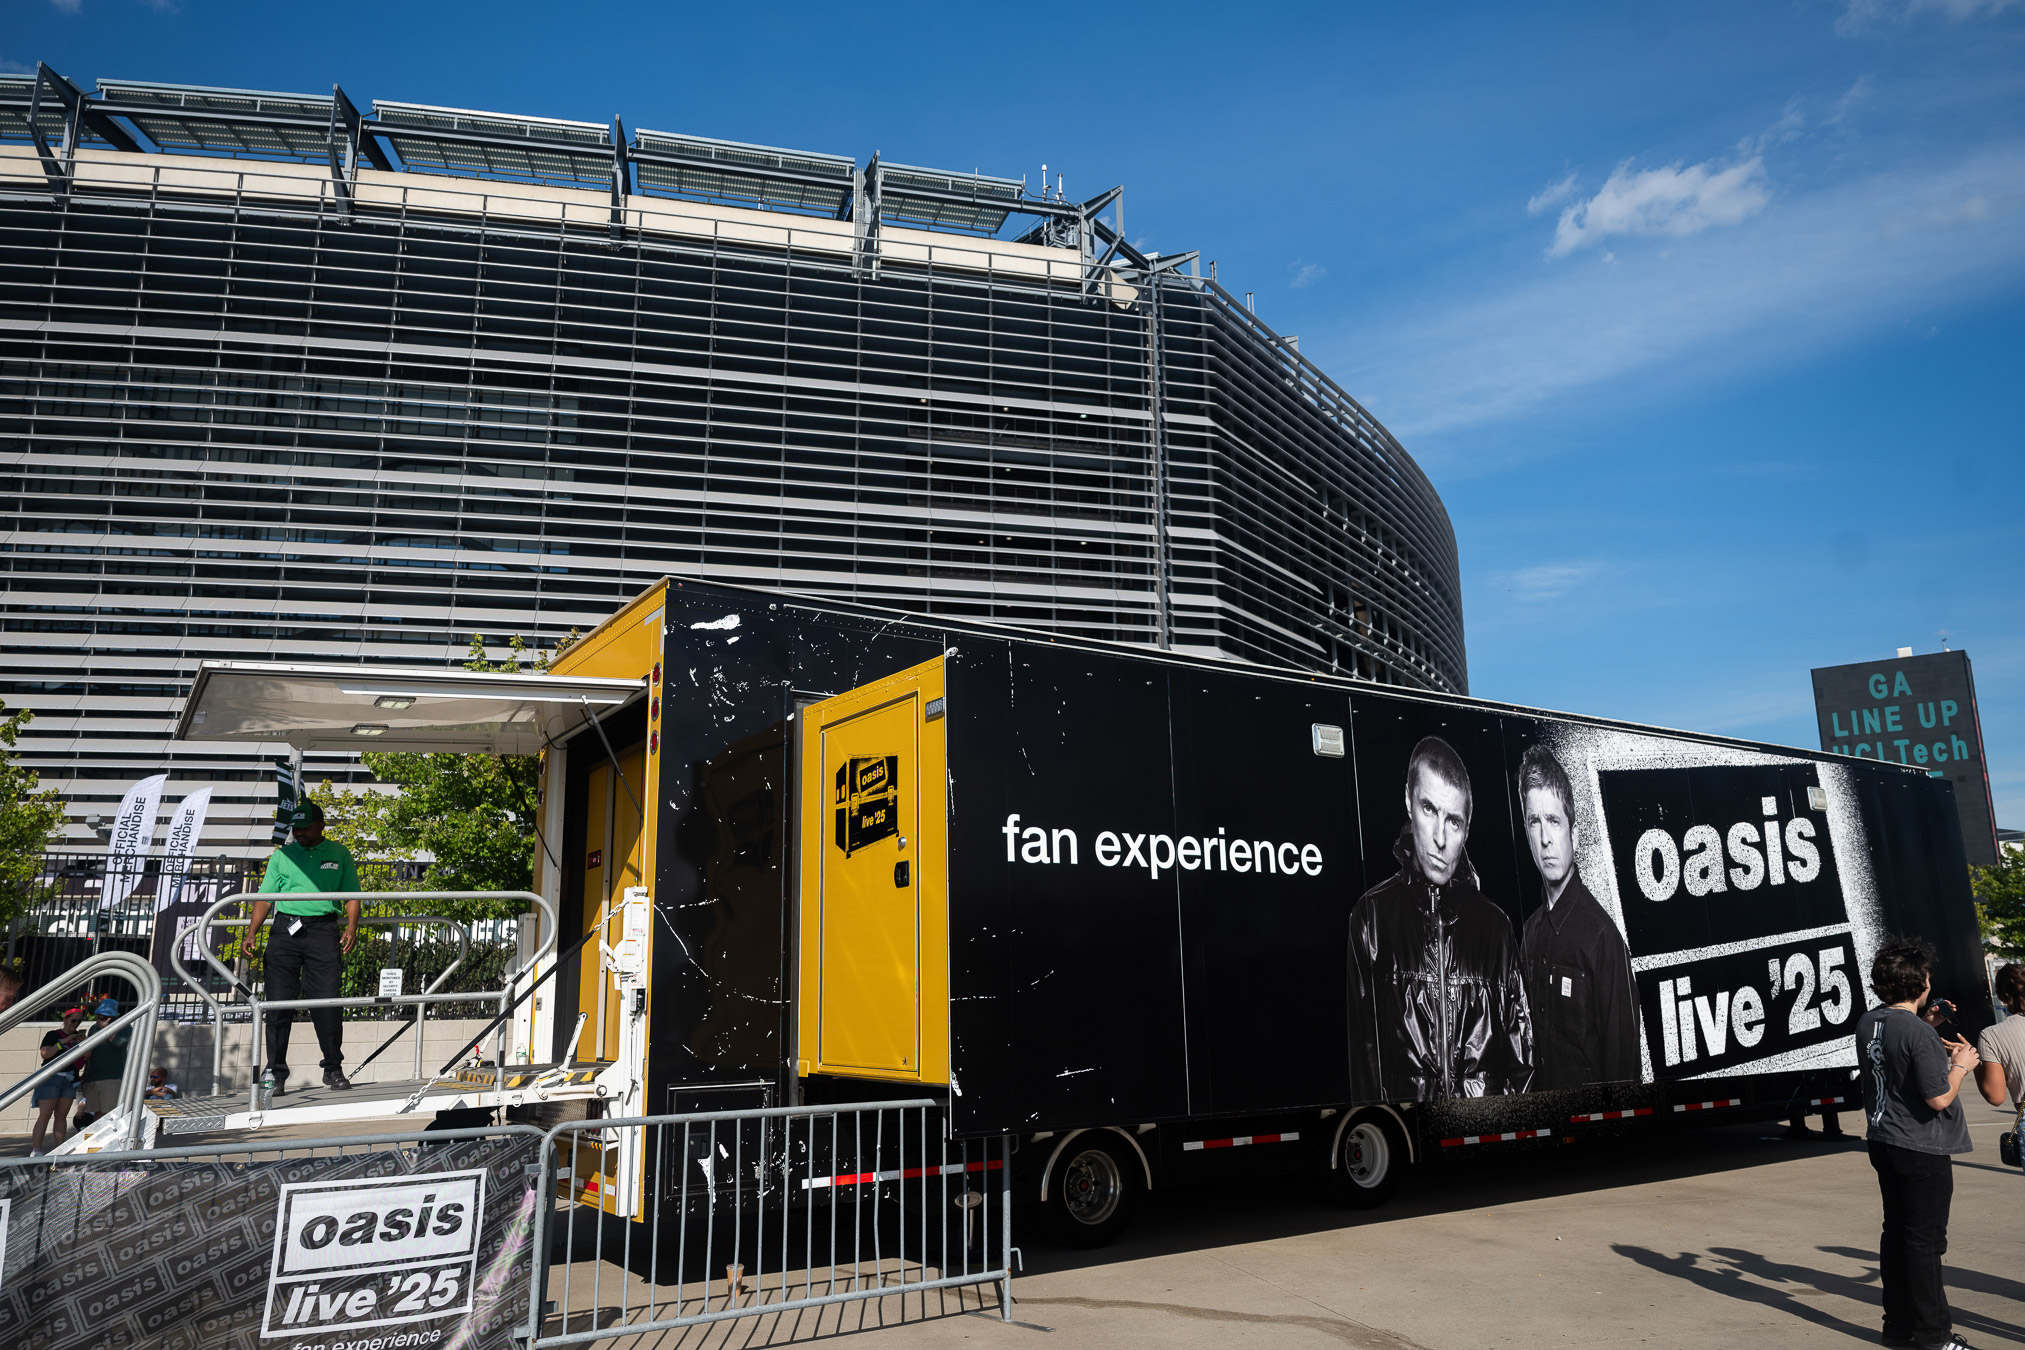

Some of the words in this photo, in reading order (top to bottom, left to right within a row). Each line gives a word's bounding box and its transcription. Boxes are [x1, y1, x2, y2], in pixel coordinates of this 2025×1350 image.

[1868, 671, 1912, 699] GA
[1832, 705, 1903, 737] LINE
[1917, 700, 1958, 728] UP
[861, 765, 884, 786] oasis
[278, 799, 294, 811] JETS
[861, 815, 875, 829] live
[112, 812, 132, 865] OFFICIAL
[119, 796, 147, 883] MERCHANDISE
[1002, 813, 1079, 865] fan
[1095, 827, 1323, 880] experience
[1634, 795, 1822, 901] oasis
[1659, 976, 1765, 1067] live
[149, 1170, 215, 1206] oasis
[206, 1182, 270, 1219] oasis
[61, 1206, 129, 1245] oasis
[119, 1220, 187, 1261] oasis
[299, 1193, 465, 1250] oasis
[177, 1235, 242, 1275] oasis
[31, 1261, 99, 1303] oasis
[88, 1275, 157, 1317] oasis
[147, 1287, 213, 1328] oasis
[282, 1285, 377, 1325] live
[340, 1329, 441, 1350] experience
